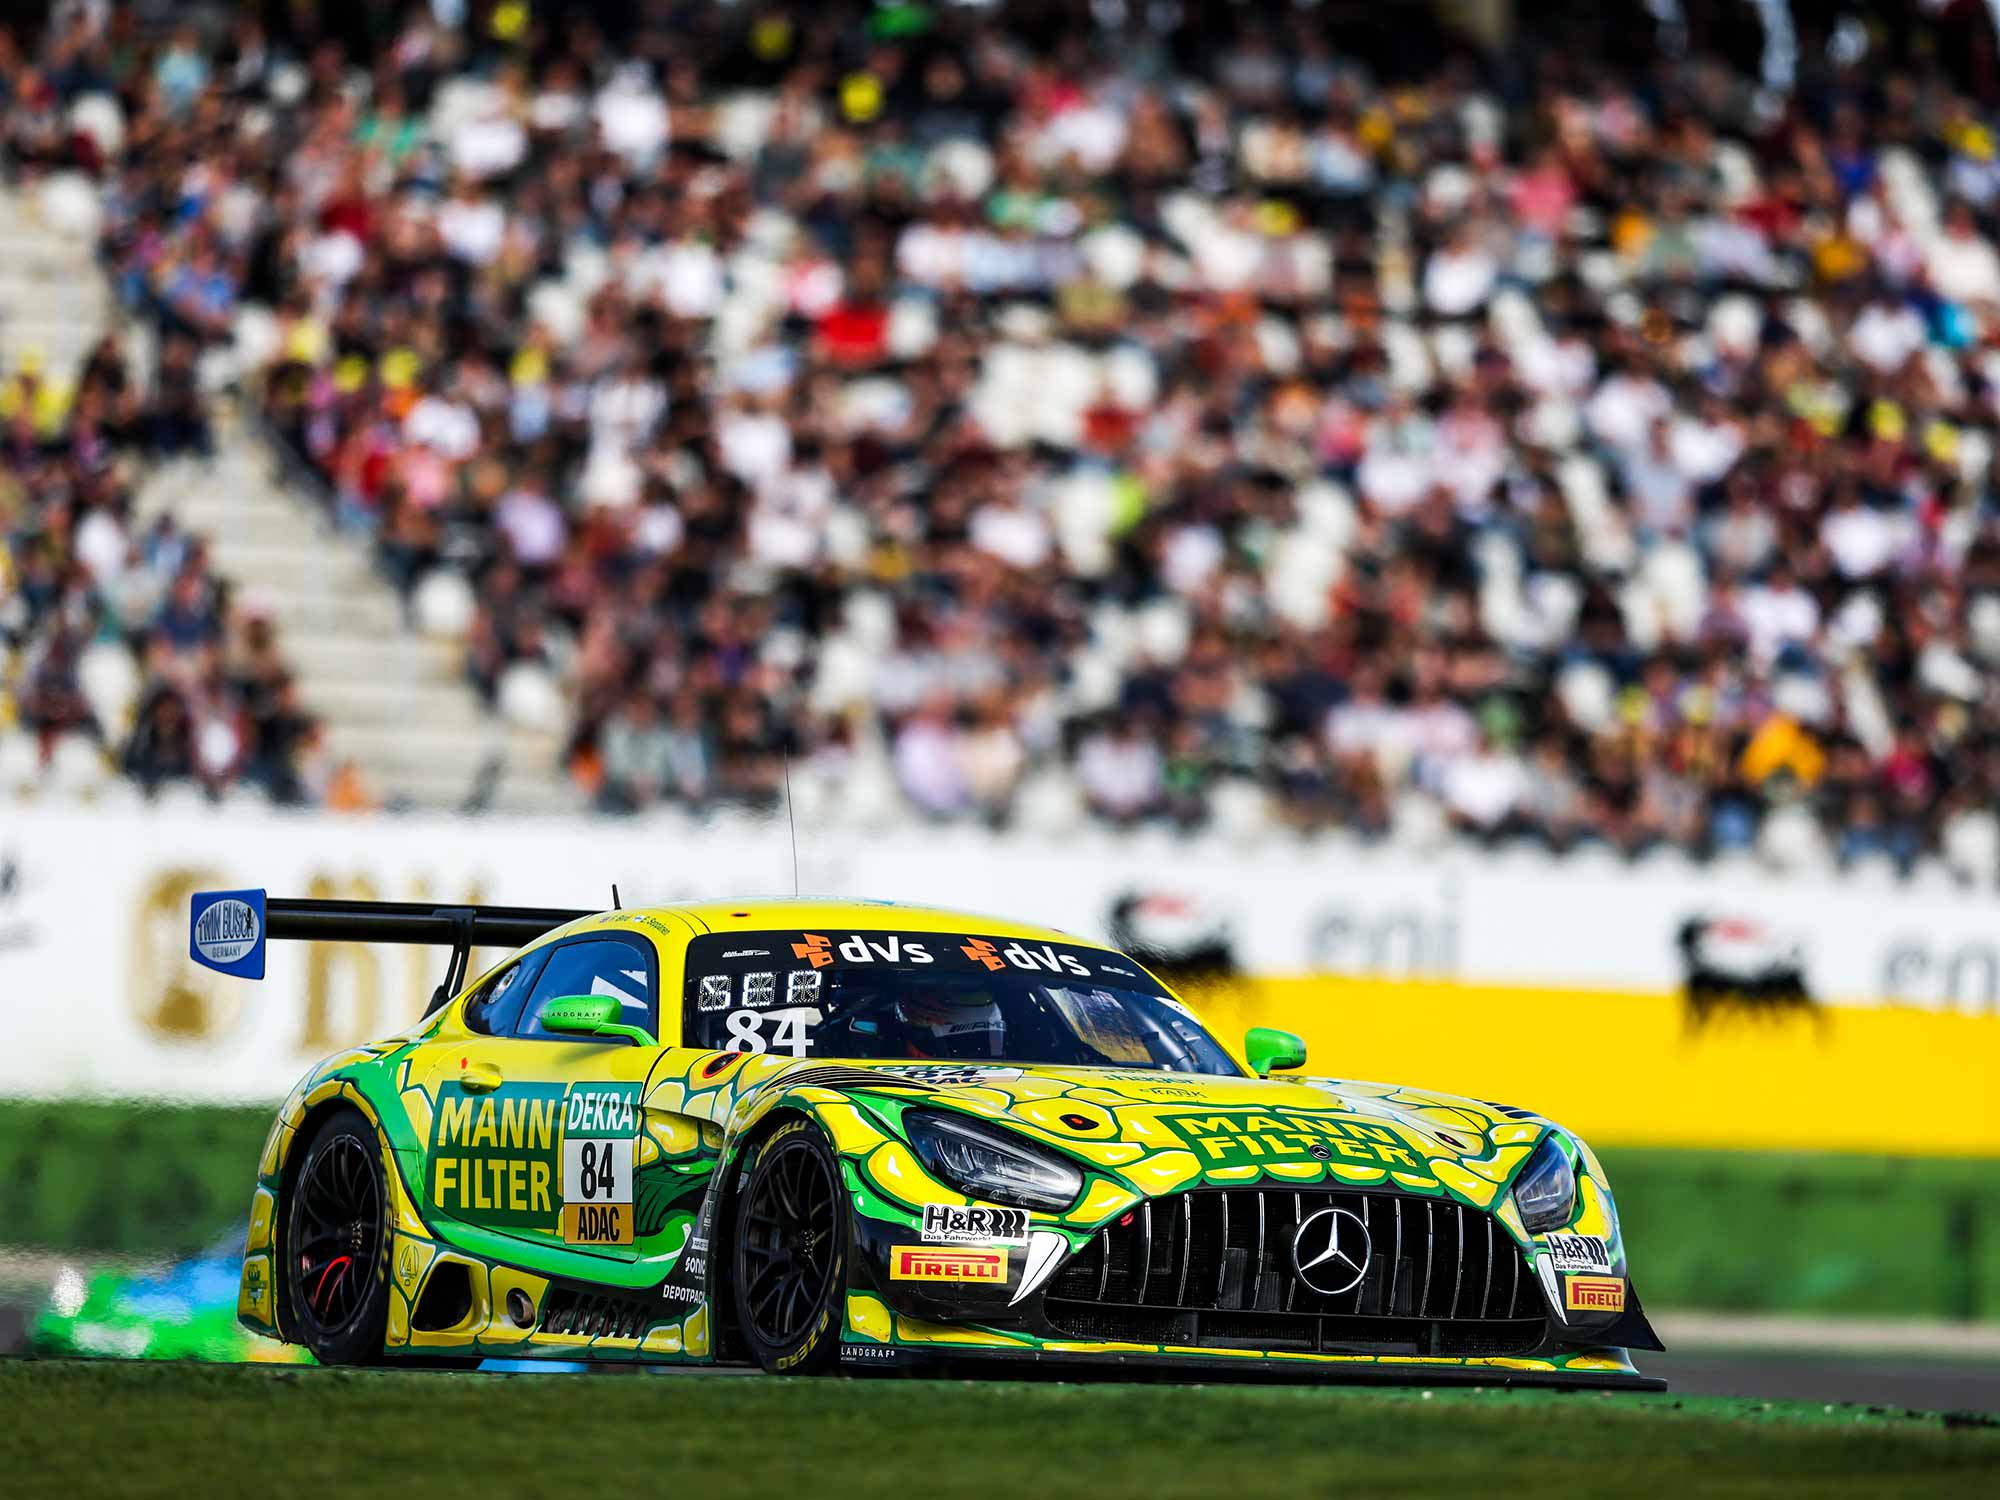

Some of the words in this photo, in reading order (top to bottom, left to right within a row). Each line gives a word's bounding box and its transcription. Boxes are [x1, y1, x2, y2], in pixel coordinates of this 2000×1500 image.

[198, 902, 221, 942] TWIN
[212, 945, 241, 958] GERMANY
[725, 1009, 815, 1058] 84
[436, 1097, 556, 1150] MANN
[568, 1092, 634, 1131] DEKRA
[1174, 1116, 1398, 1145] MANN
[1197, 1134, 1420, 1168] FILTER
[434, 1158, 552, 1212] FILTER
[580, 1141, 615, 1200] 84
[577, 1206, 620, 1242] ADAC
[901, 1252, 1001, 1278] PIRELLI
[1572, 1282, 1622, 1307] PIRELLI
